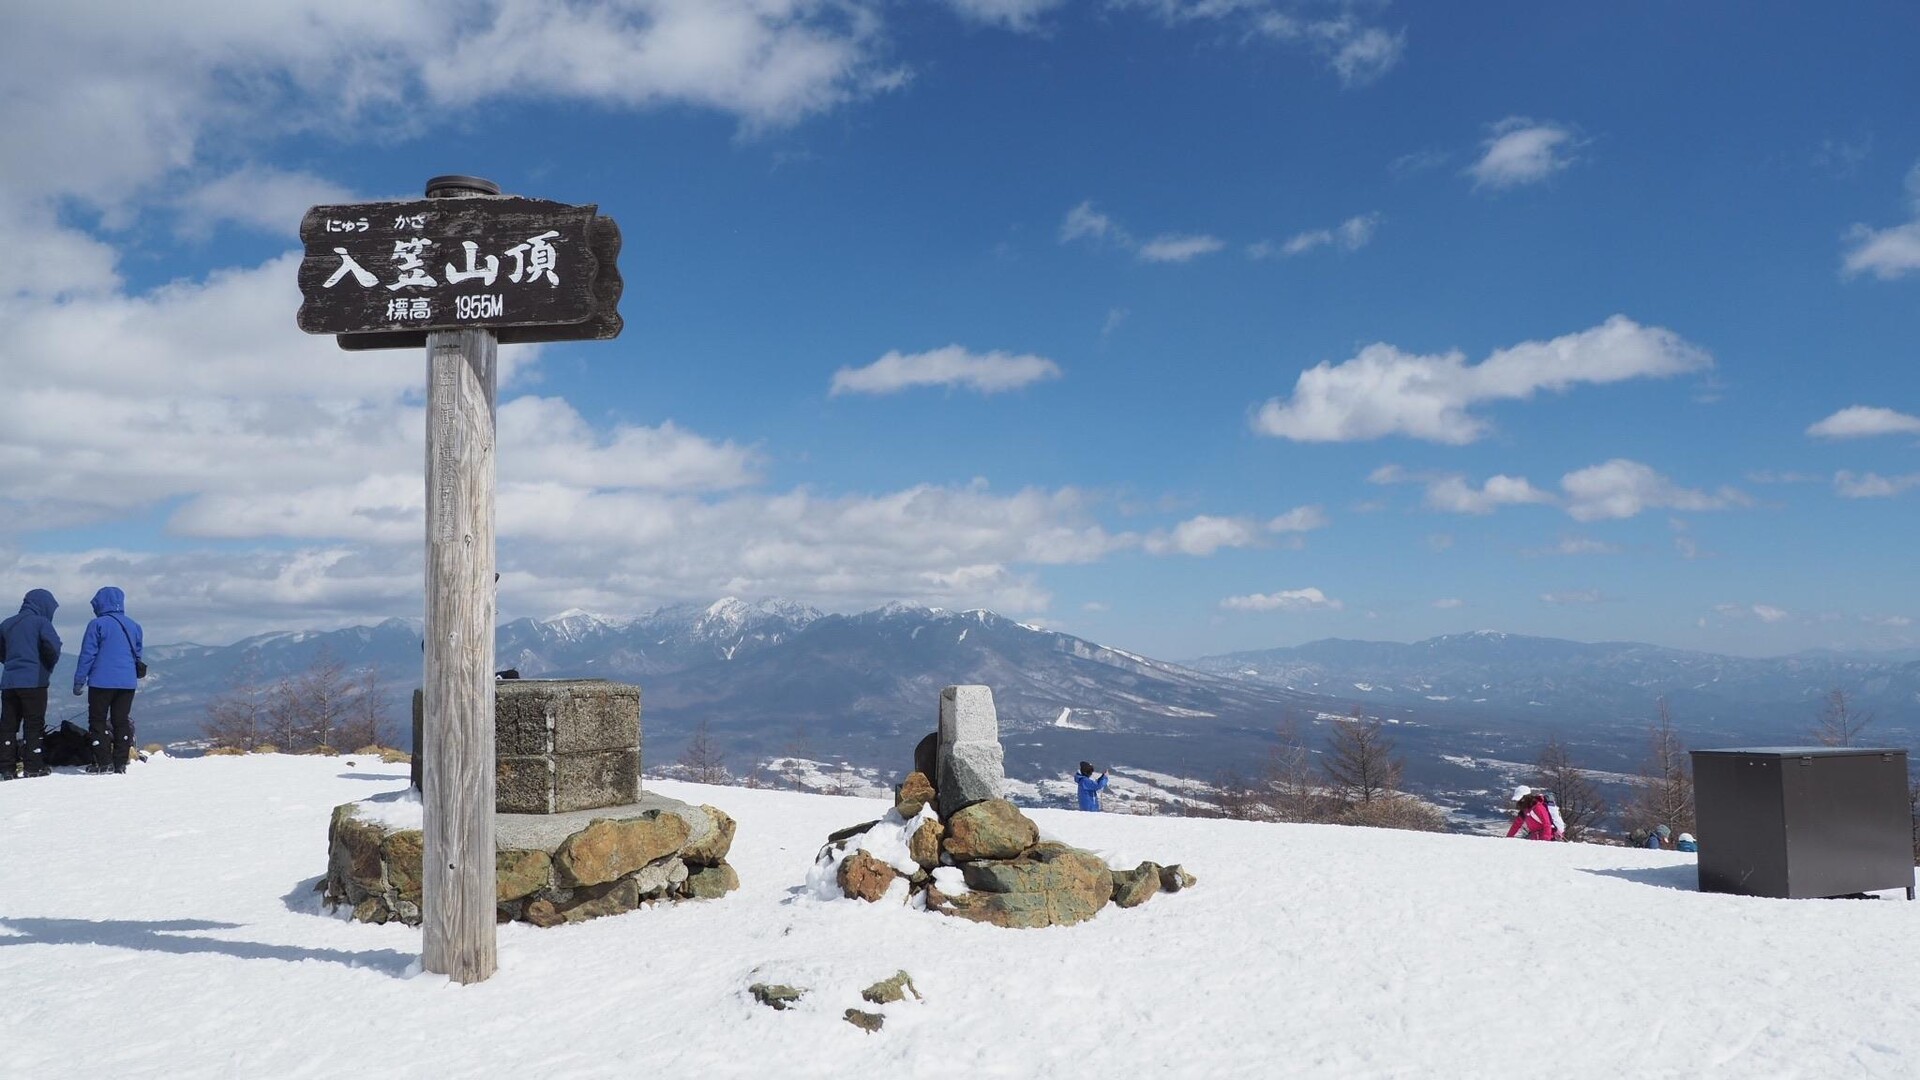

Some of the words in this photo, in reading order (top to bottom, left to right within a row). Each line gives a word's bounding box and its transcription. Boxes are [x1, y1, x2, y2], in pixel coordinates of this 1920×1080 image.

[326, 217, 370, 233] にゅう
[322, 230, 561, 291] 入笠山頂
[386, 296, 431, 321] 標高
[455, 294, 504, 320] 1955M
